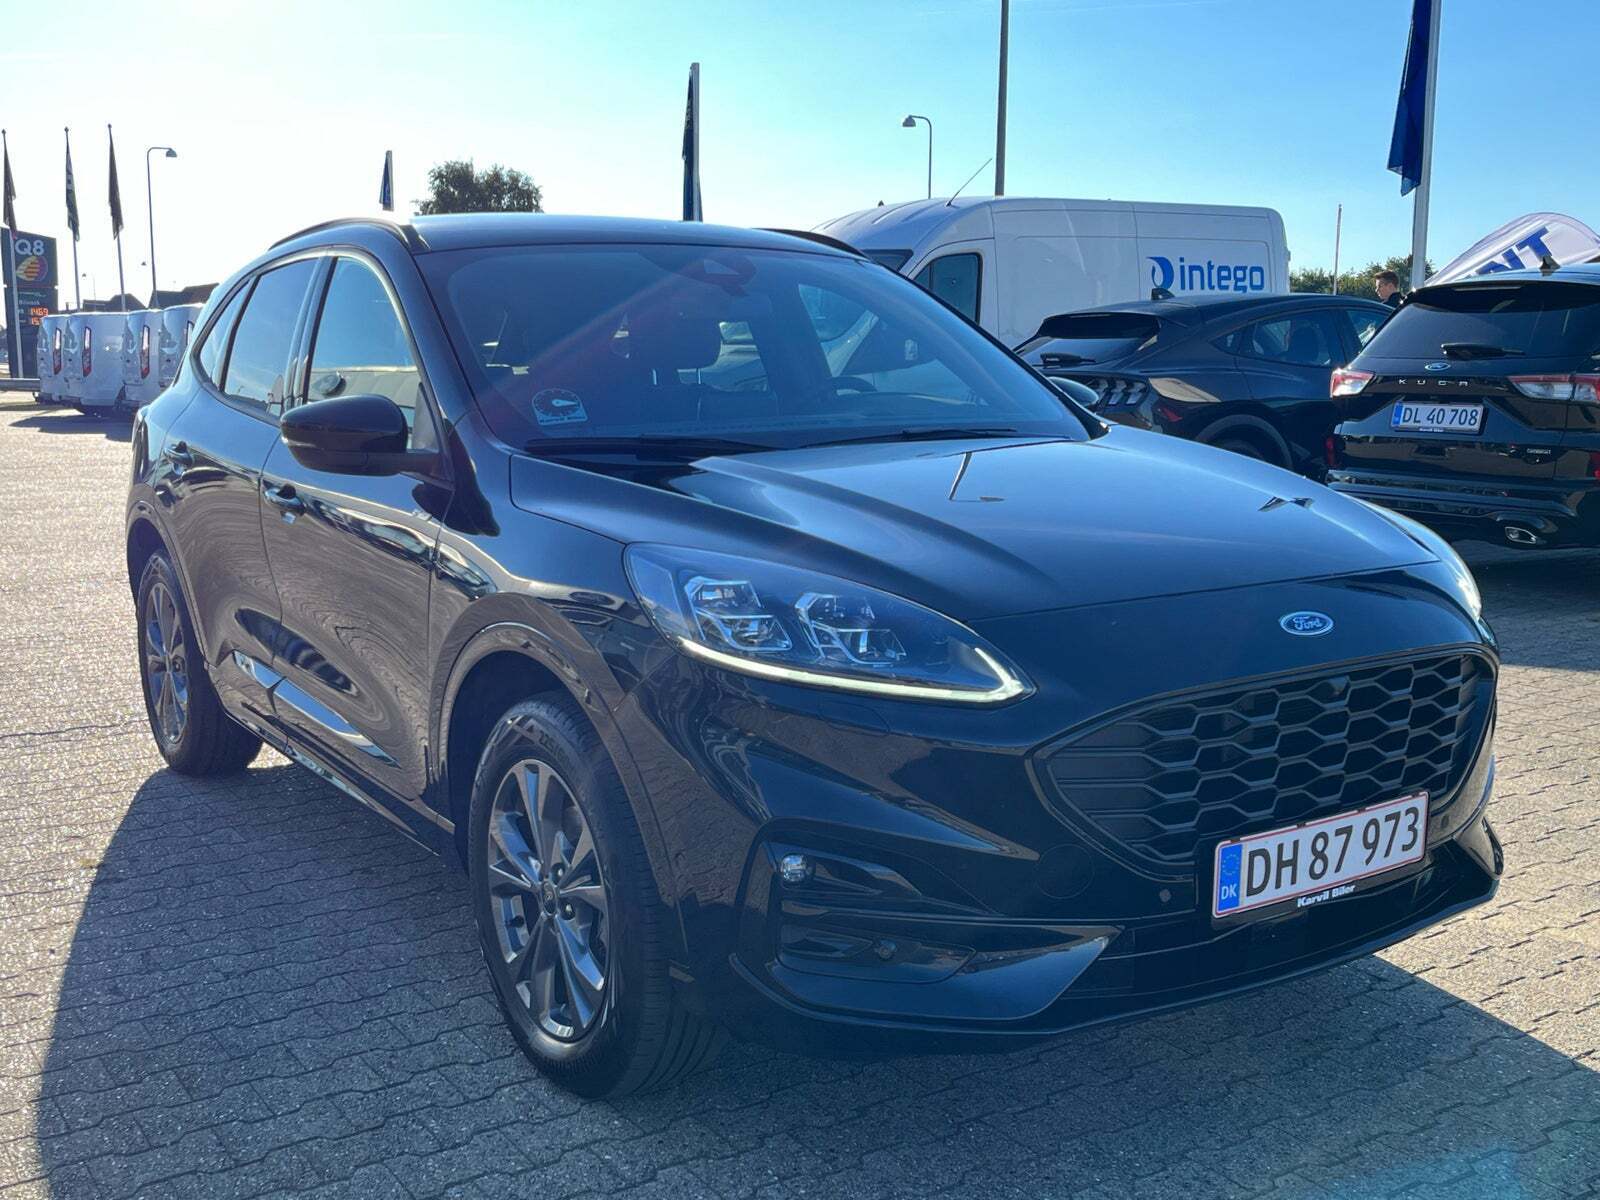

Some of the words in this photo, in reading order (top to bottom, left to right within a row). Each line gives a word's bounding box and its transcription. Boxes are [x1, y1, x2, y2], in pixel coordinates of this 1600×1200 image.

[15, 239, 45, 256] Q8
[1475, 226, 1553, 275] NT
[1179, 256, 1265, 293] intego
[1398, 378, 1469, 387] KUGA
[1402, 407, 1421, 424] DL
[1426, 407, 1445, 425] 40
[1449, 408, 1479, 426] 708
[1293, 616, 1322, 630] Ford
[1246, 839, 1299, 897] DH
[1308, 825, 1353, 880] 87
[1362, 806, 1419, 866] 973
[1221, 883, 1237, 900] DK
[1331, 884, 1356, 899] Biler
